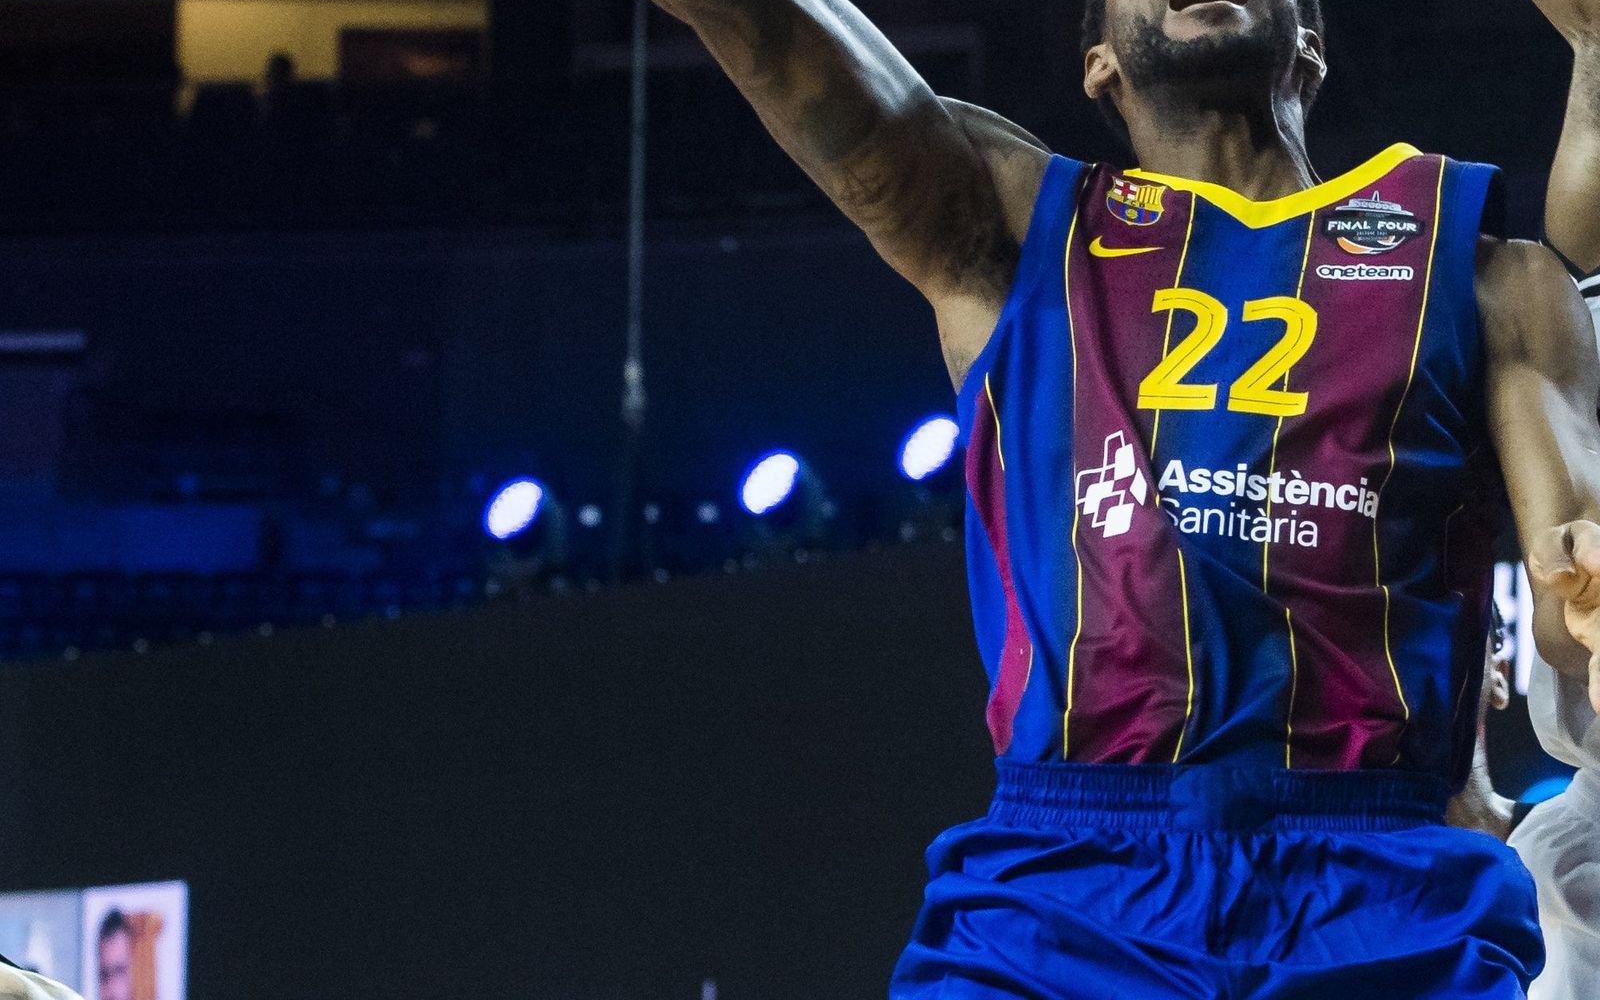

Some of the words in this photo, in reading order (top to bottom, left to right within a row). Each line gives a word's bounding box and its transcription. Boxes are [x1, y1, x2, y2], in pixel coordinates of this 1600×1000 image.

[1328, 221, 1371, 232] FINAL
[1377, 221, 1417, 232] FOUR
[1318, 265, 1412, 278] oneteam
[1137, 288, 1318, 417] 22
[1158, 459, 1379, 519] Assistència
